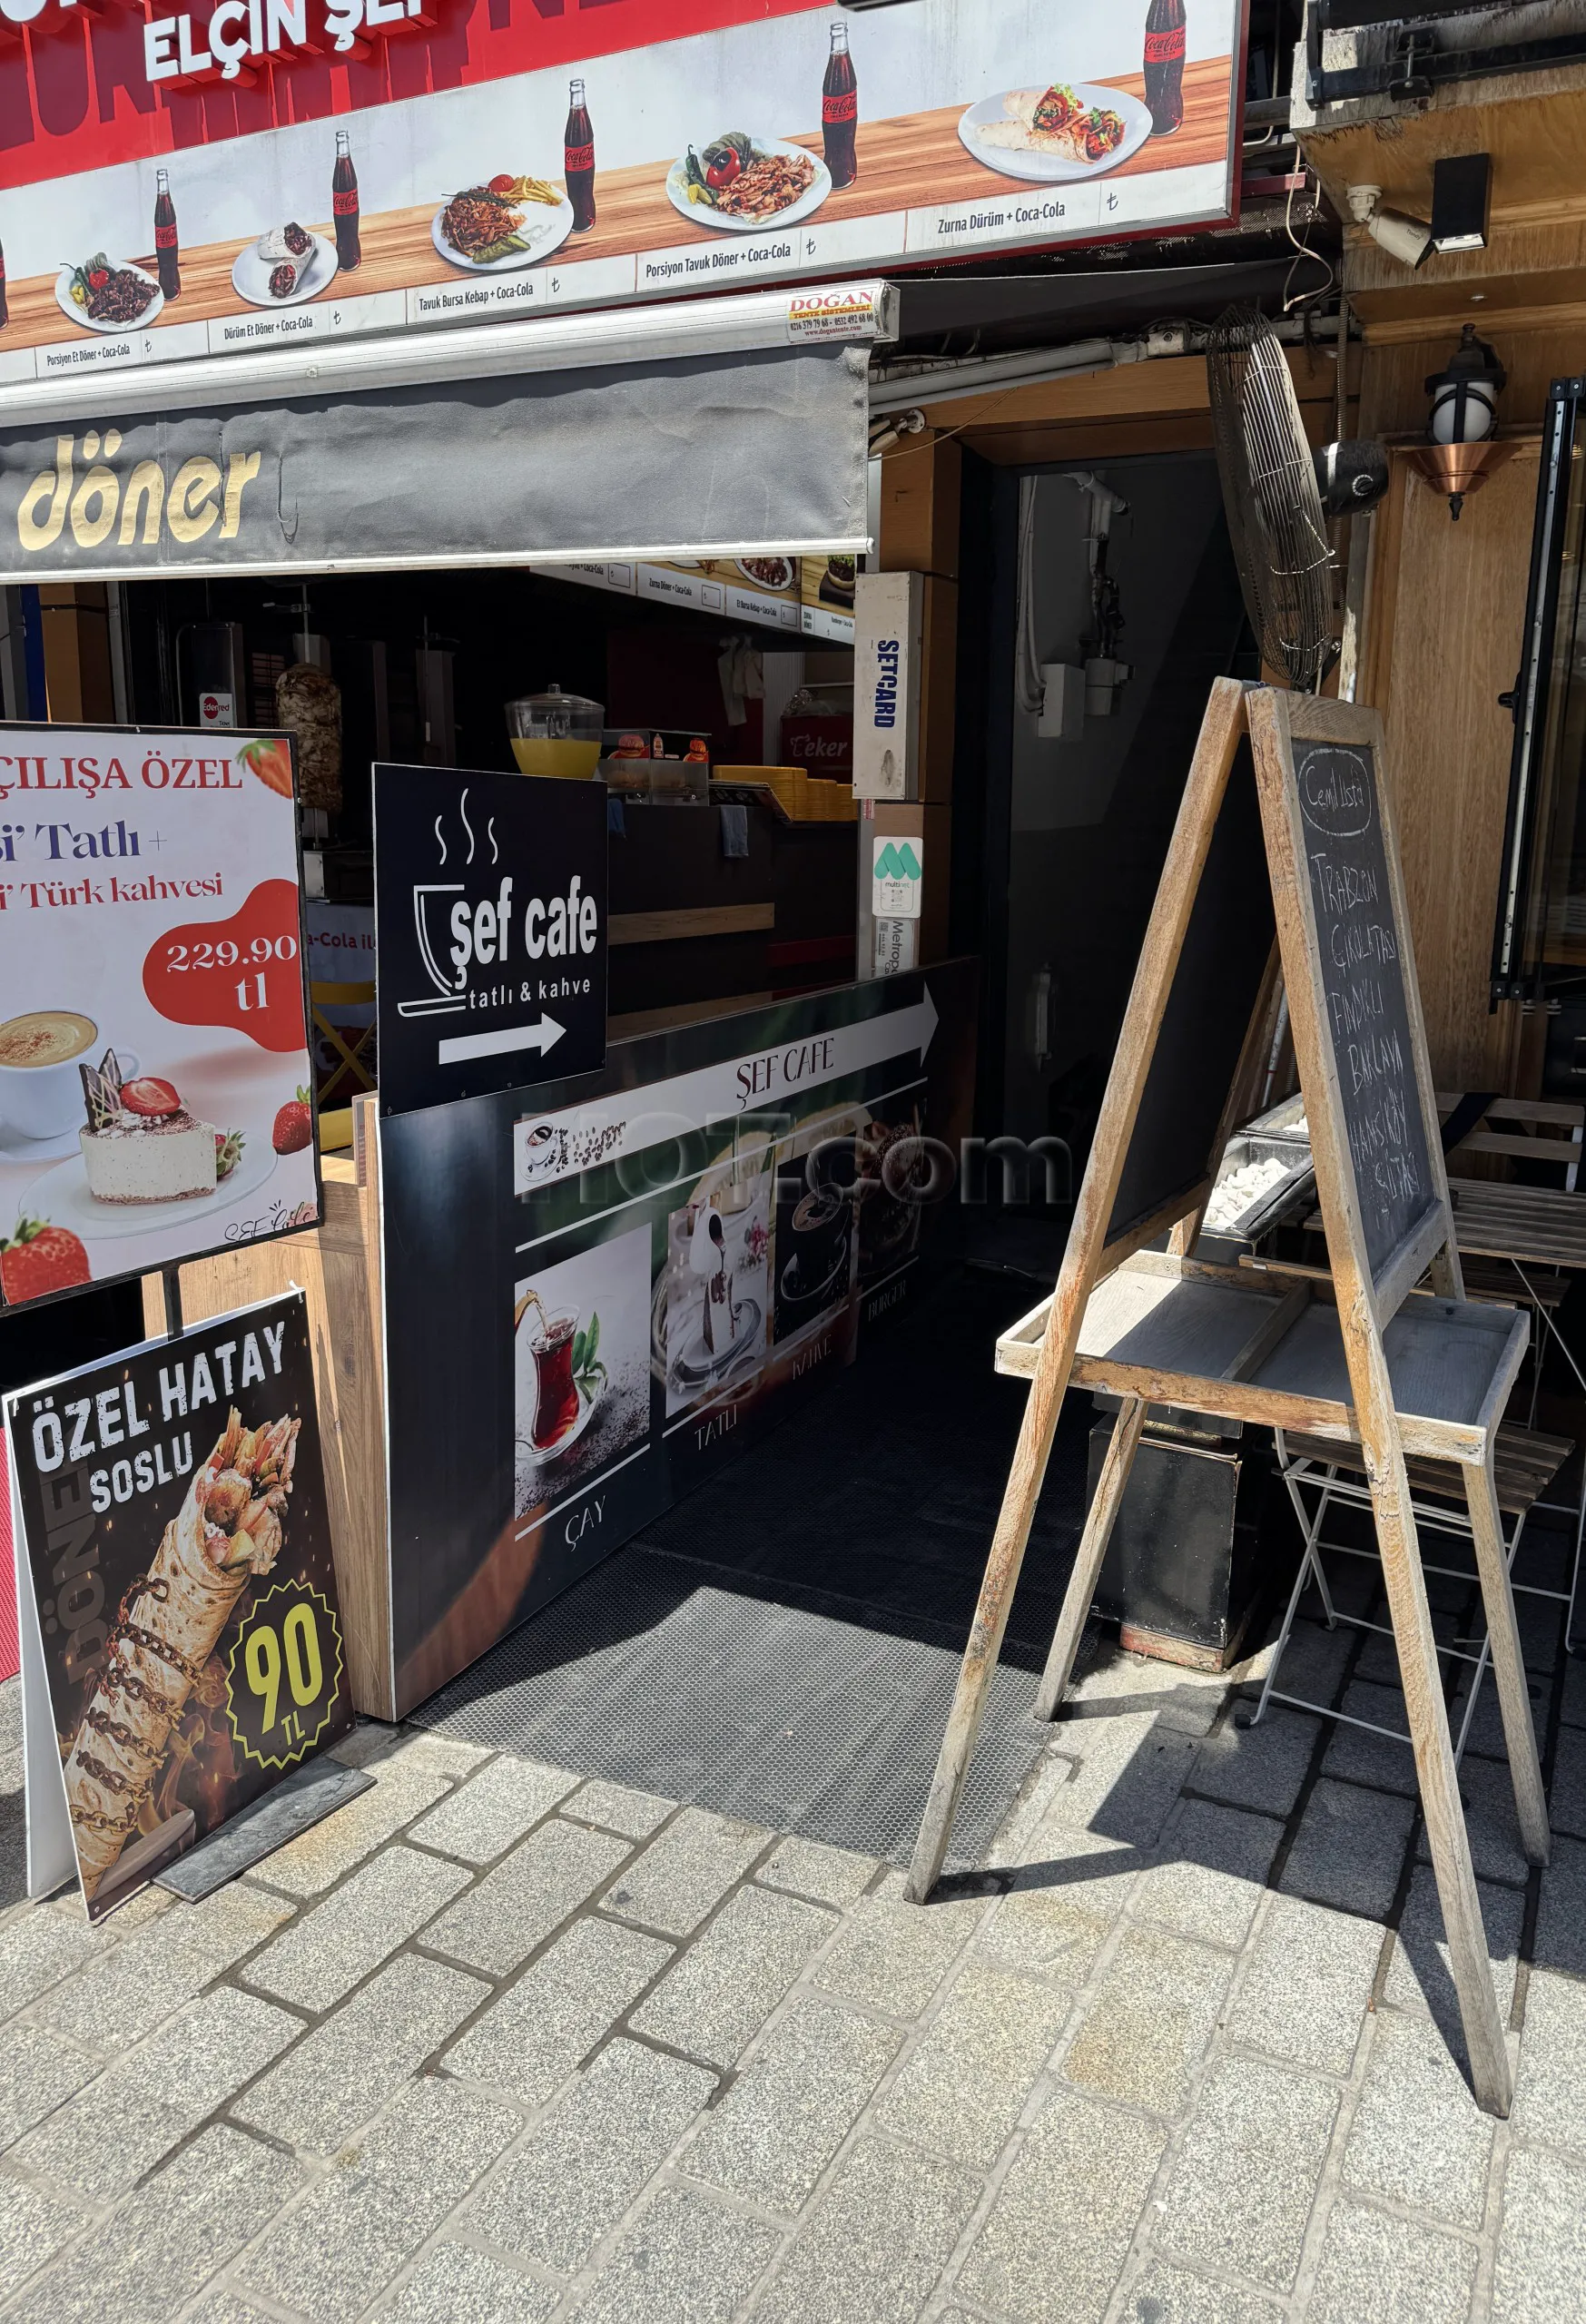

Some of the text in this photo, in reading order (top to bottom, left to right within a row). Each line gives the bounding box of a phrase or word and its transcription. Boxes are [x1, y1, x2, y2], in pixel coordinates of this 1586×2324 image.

[938, 219, 968, 234] Zurna
[970, 212, 1004, 230] Dürüm
[1015, 201, 1066, 223] Coca-Cola
[645, 261, 684, 278] Porsiyon
[684, 254, 710, 272] Tavuk
[712, 252, 739, 268] Döner
[747, 242, 791, 262] Coca-Cola
[419, 295, 441, 311] Tavuk
[442, 293, 464, 308] Bursa
[465, 290, 489, 305] Kebap
[497, 281, 534, 300] Coca-Cola
[790, 291, 873, 312] DOĞAN
[224, 325, 246, 340] Dürüm
[247, 324, 254, 337] Et
[255, 321, 274, 336] Döner
[281, 316, 313, 332] Coca-Cola
[46, 352, 72, 367] Porsiyon
[72, 352, 79, 362] Et
[79, 349, 97, 362] Döner
[102, 343, 131, 359] Coca-Cola
[17, 428, 261, 551] döner
[874, 639, 900, 728] SETCARD
[141, 750, 243, 789] ÖZEL
[34, 820, 142, 861] Tatlı
[21, 877, 106, 909] Türk
[109, 872, 224, 903] kahvesi
[449, 874, 597, 990] şef cafe
[166, 935, 297, 973] 229.90
[233, 971, 271, 1011] tl
[469, 977, 591, 1009] tatlı & kahve
[736, 1038, 835, 1110] ŞEF CAFE
[33, 1322, 287, 1472] ÖZEL HATAY
[694, 1403, 738, 1451] TATLI
[90, 1432, 195, 1514] SOSLU
[565, 1494, 606, 1552] ÇAY
[244, 1601, 325, 1734] 90
[281, 1717, 306, 1747] TL
